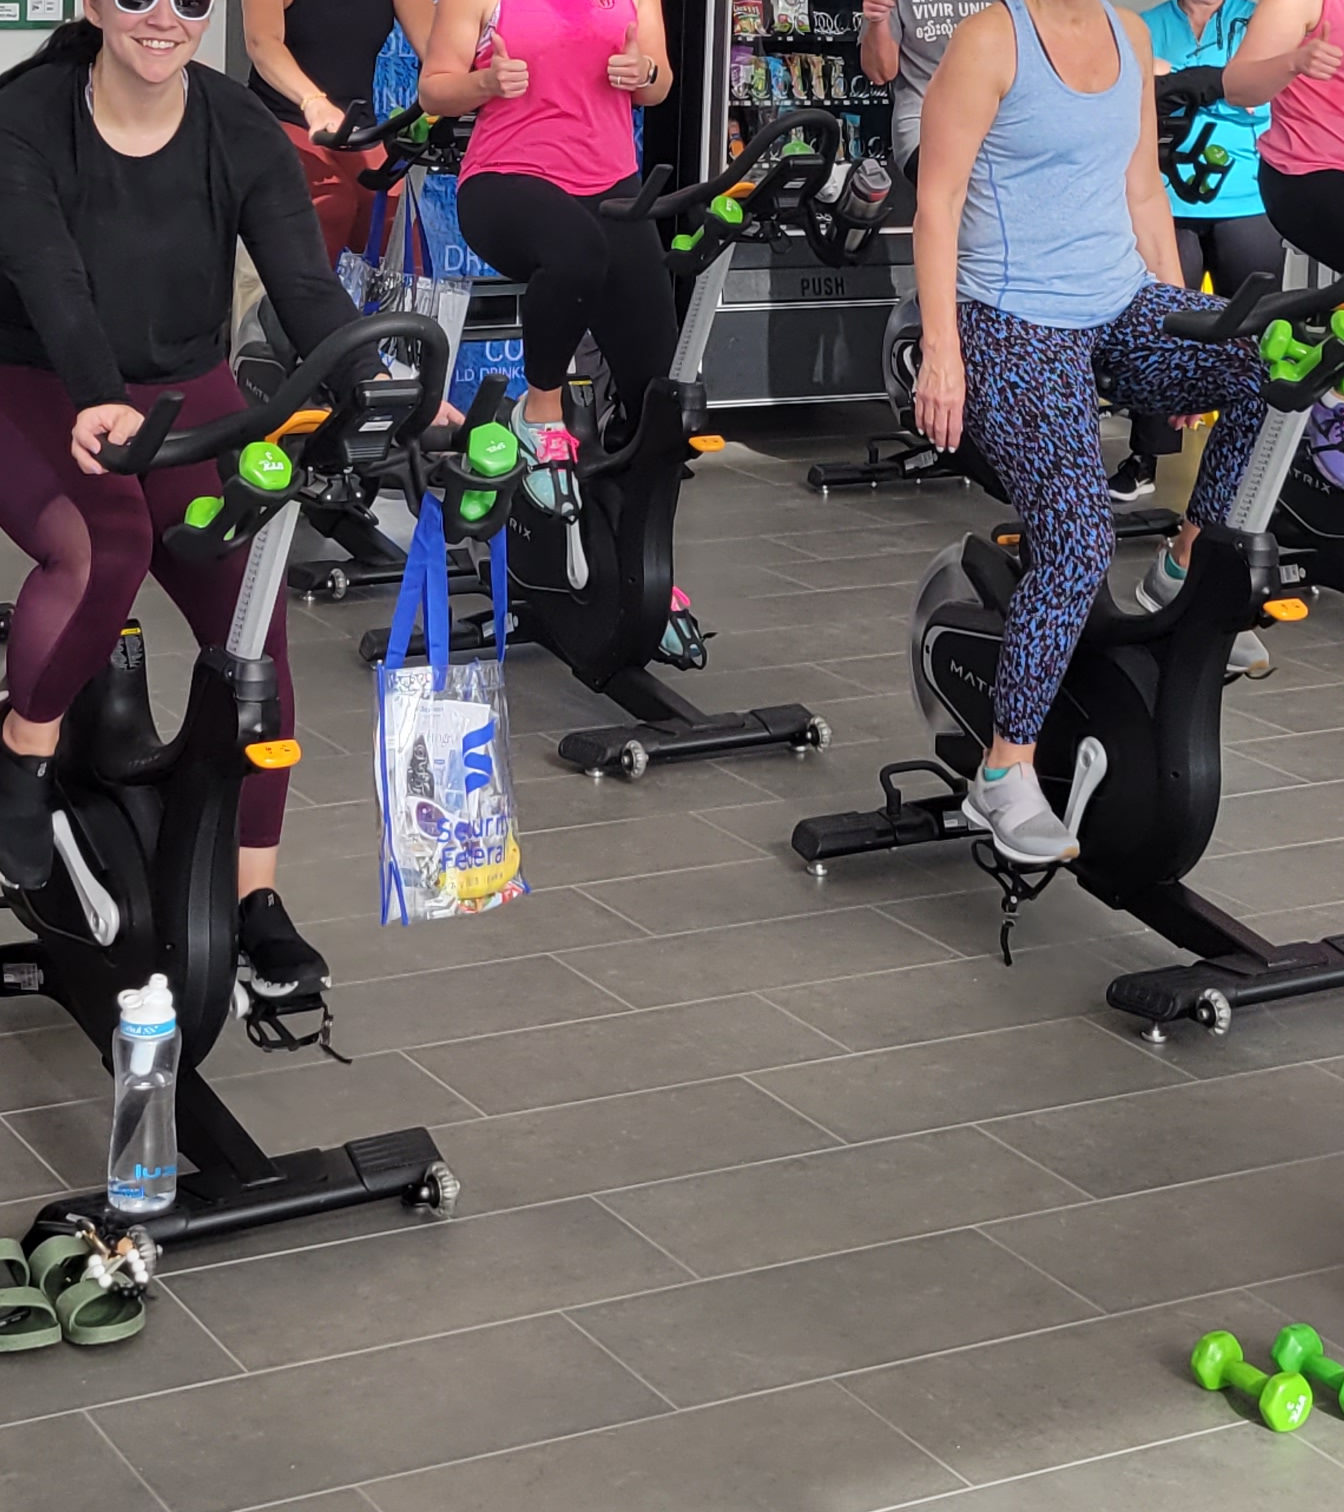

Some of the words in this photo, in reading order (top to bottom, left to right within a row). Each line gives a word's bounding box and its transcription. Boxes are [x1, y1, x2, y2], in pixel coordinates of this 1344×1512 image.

[912, 2, 954, 20] VIVIR
[958, 2, 993, 17] UNI
[800, 277, 846, 297] PUSH
[1288, 467, 1331, 495] TRIX
